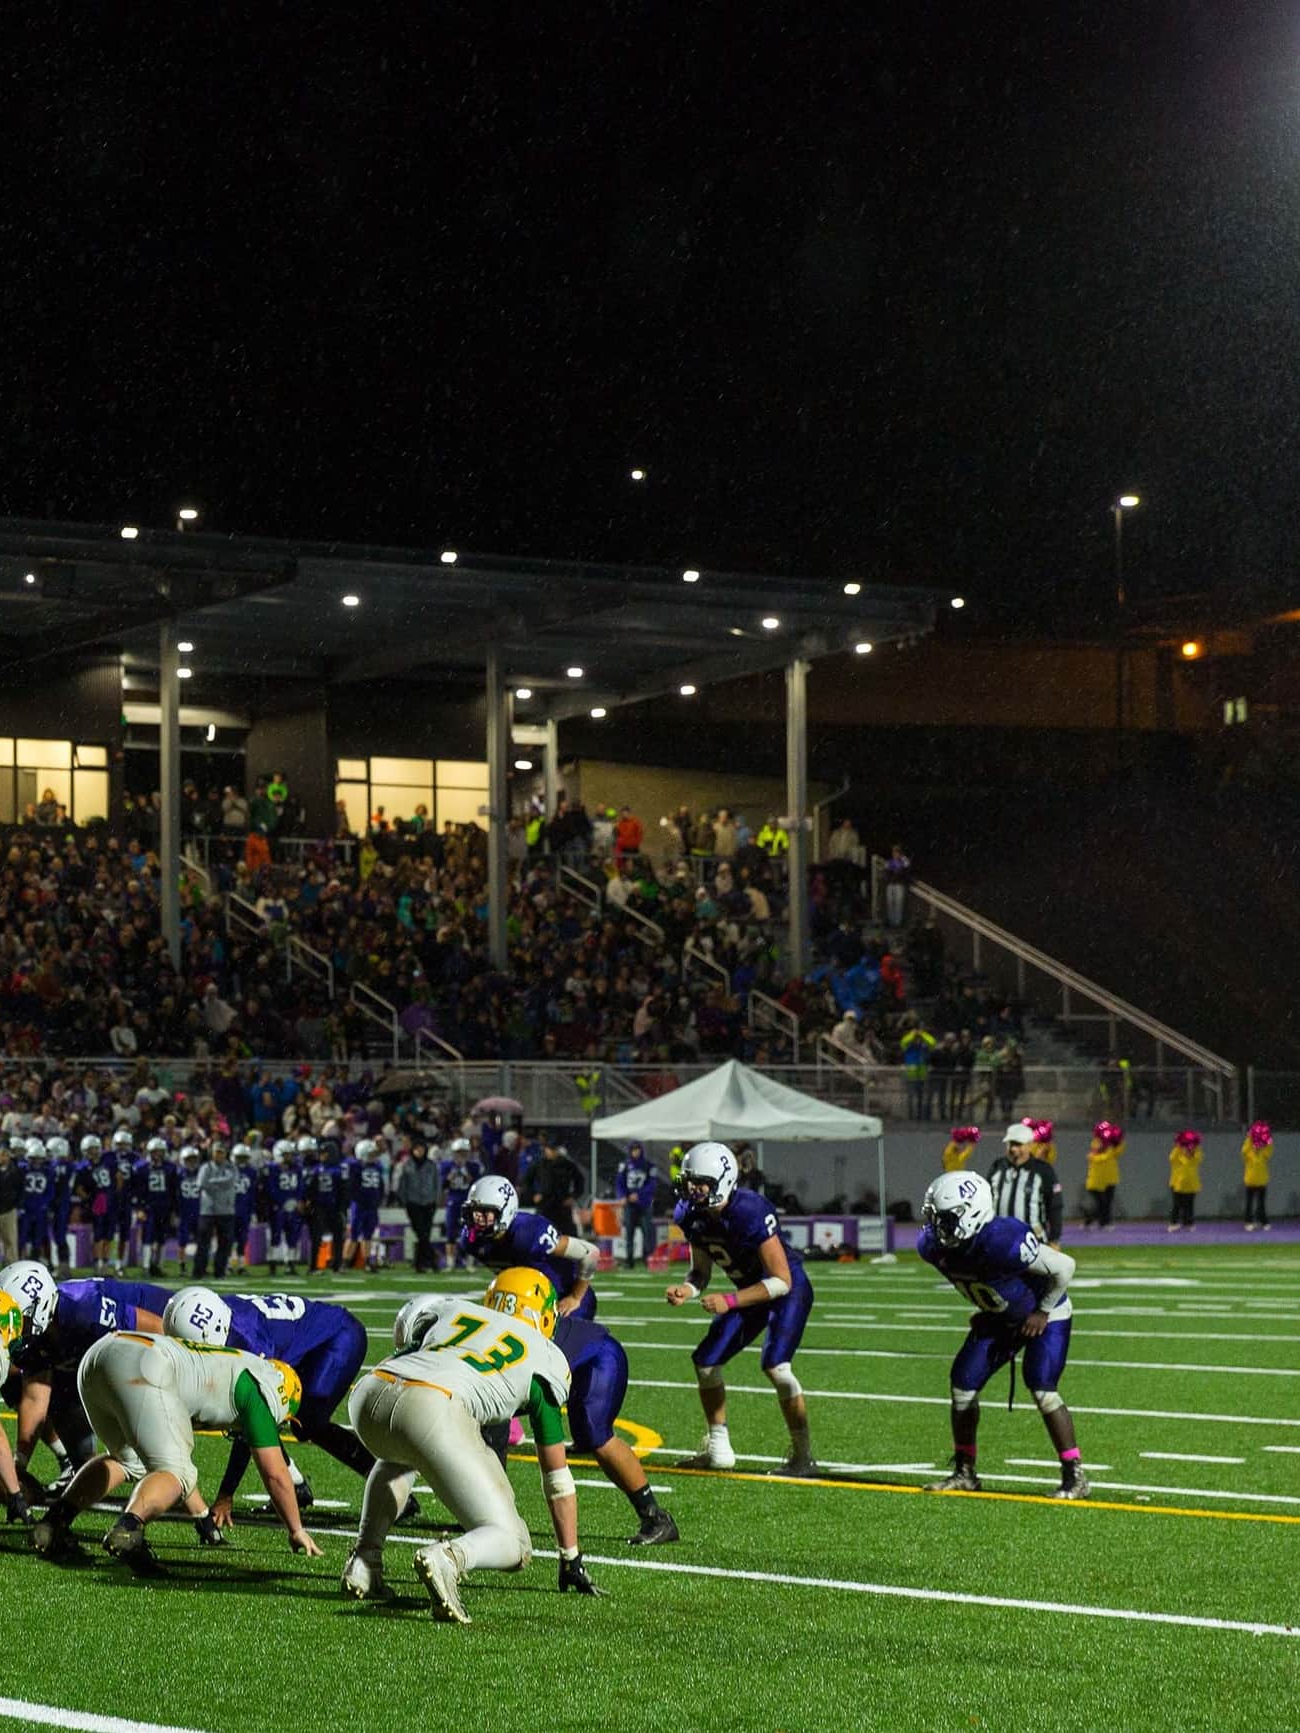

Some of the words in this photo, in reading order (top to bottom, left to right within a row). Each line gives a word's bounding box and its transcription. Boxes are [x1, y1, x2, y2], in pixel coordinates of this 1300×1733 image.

[148, 1173, 166, 1192] 21
[498, 1184, 514, 1197] 32
[958, 1179, 978, 1199] 40
[764, 1213, 778, 1236] 2
[539, 1225, 559, 1254] 32
[1019, 1231, 1040, 1264] 40
[21, 1275, 44, 1299] 53
[493, 1291, 518, 1316] 73
[189, 1303, 214, 1331] 65
[430, 1312, 529, 1377] 73
